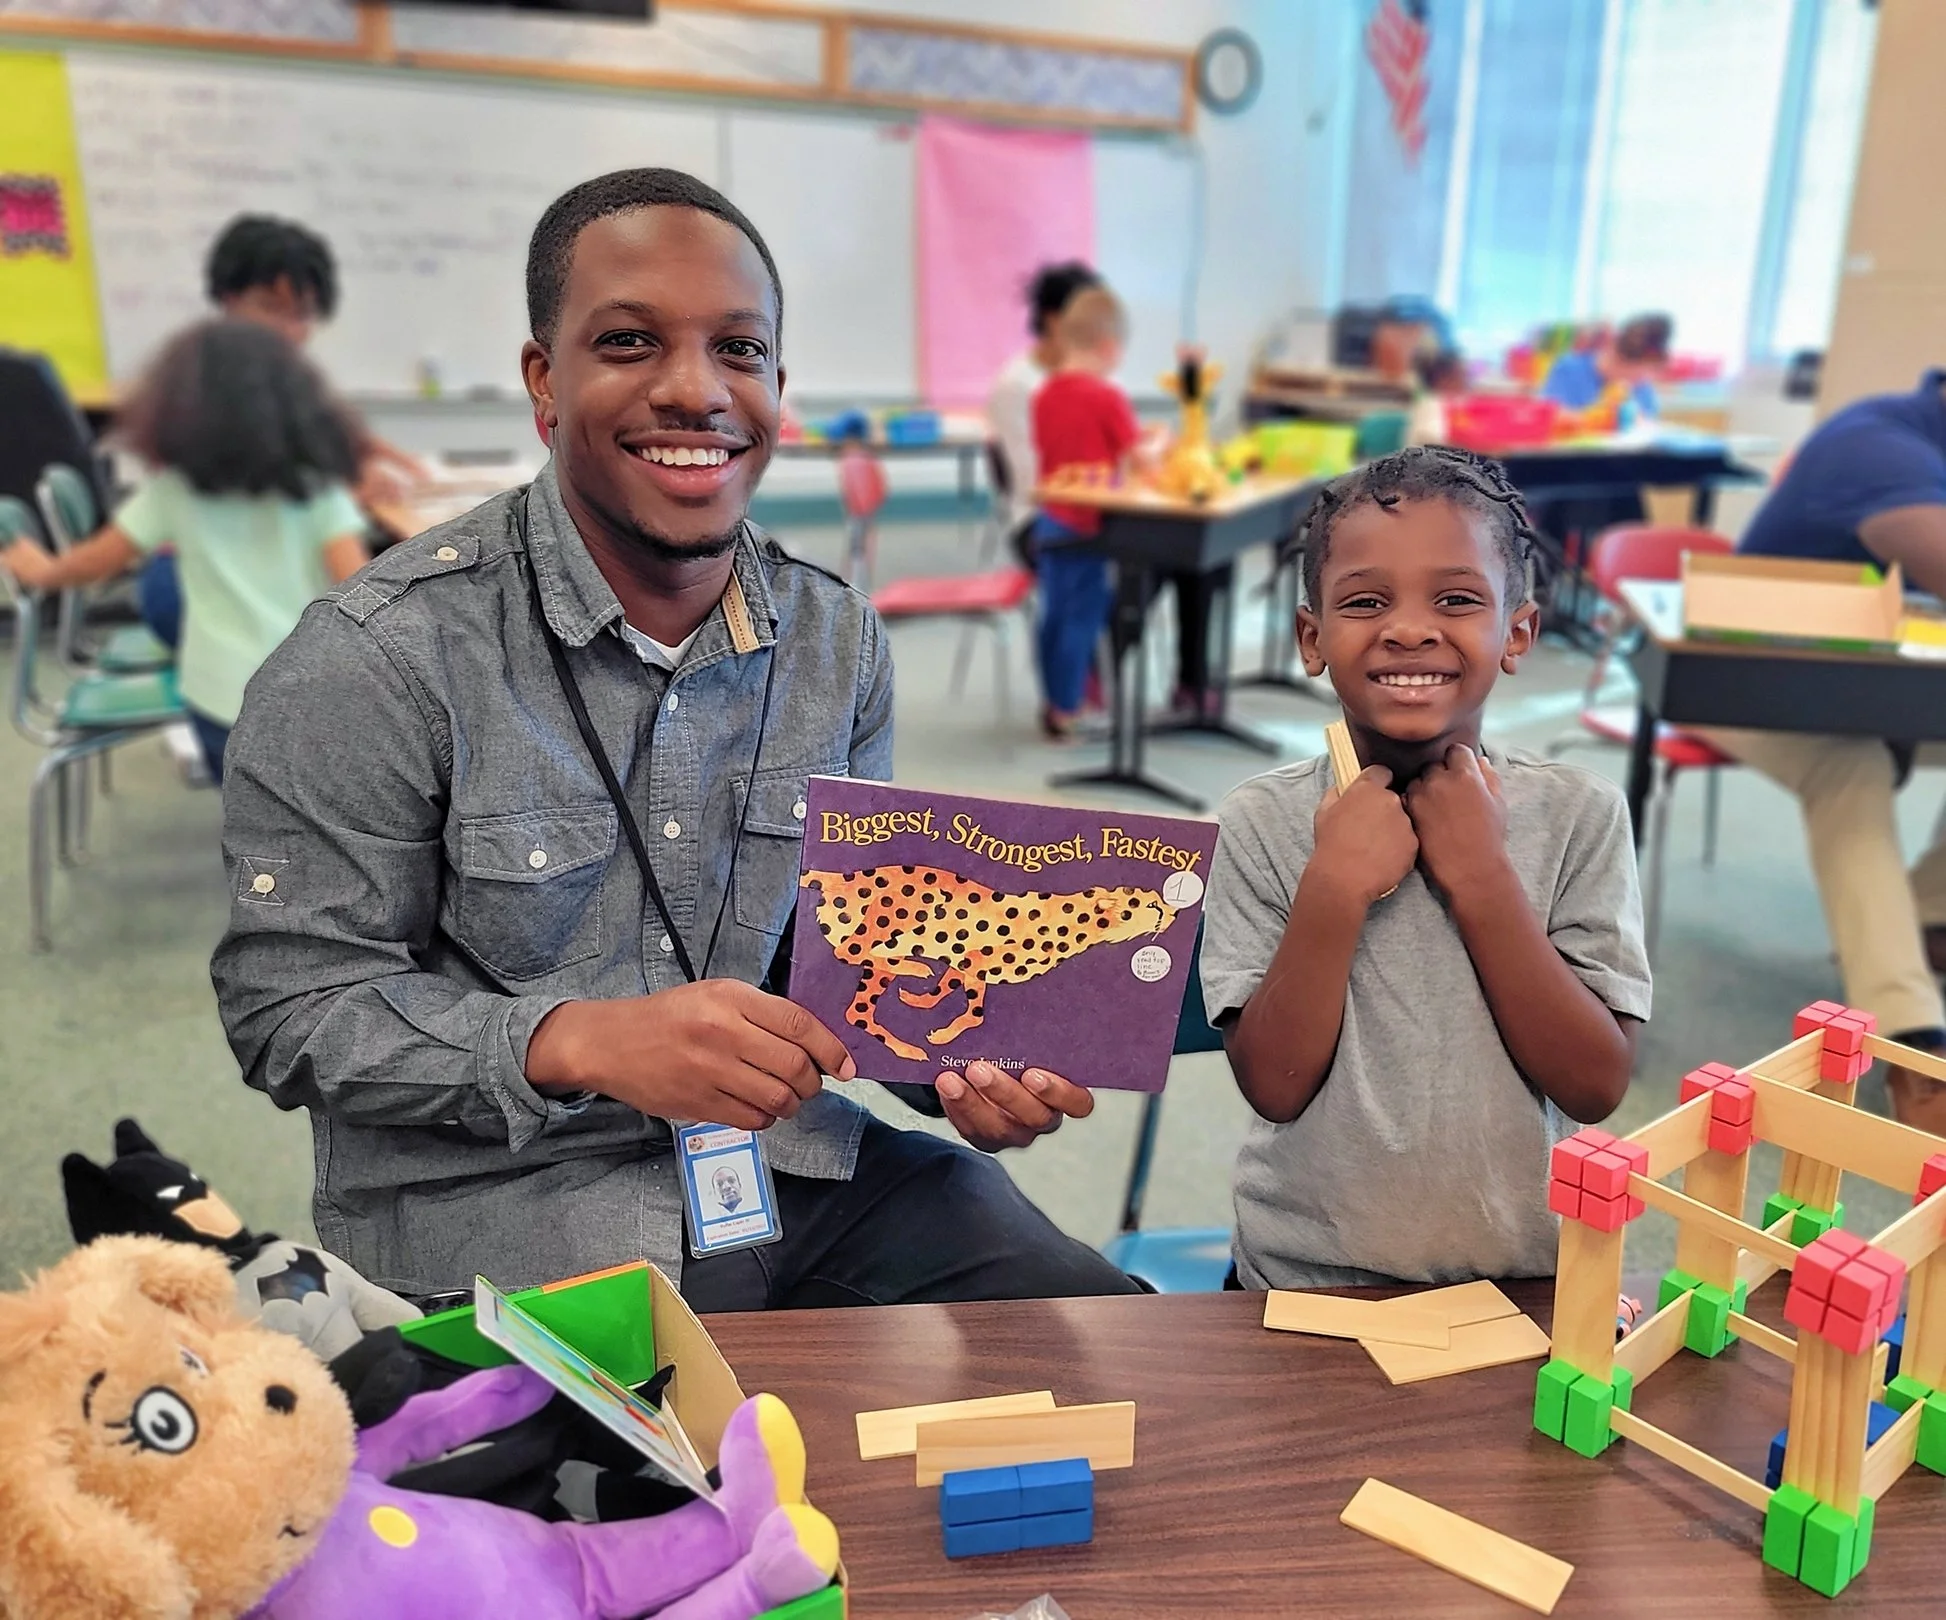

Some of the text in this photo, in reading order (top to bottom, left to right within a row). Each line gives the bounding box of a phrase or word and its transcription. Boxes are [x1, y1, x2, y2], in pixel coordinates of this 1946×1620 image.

[820, 807, 1202, 873] Biggest, Strongest, Fastest
[1167, 876, 1187, 903] 1
[710, 1136, 750, 1149] CONTRACTOR
